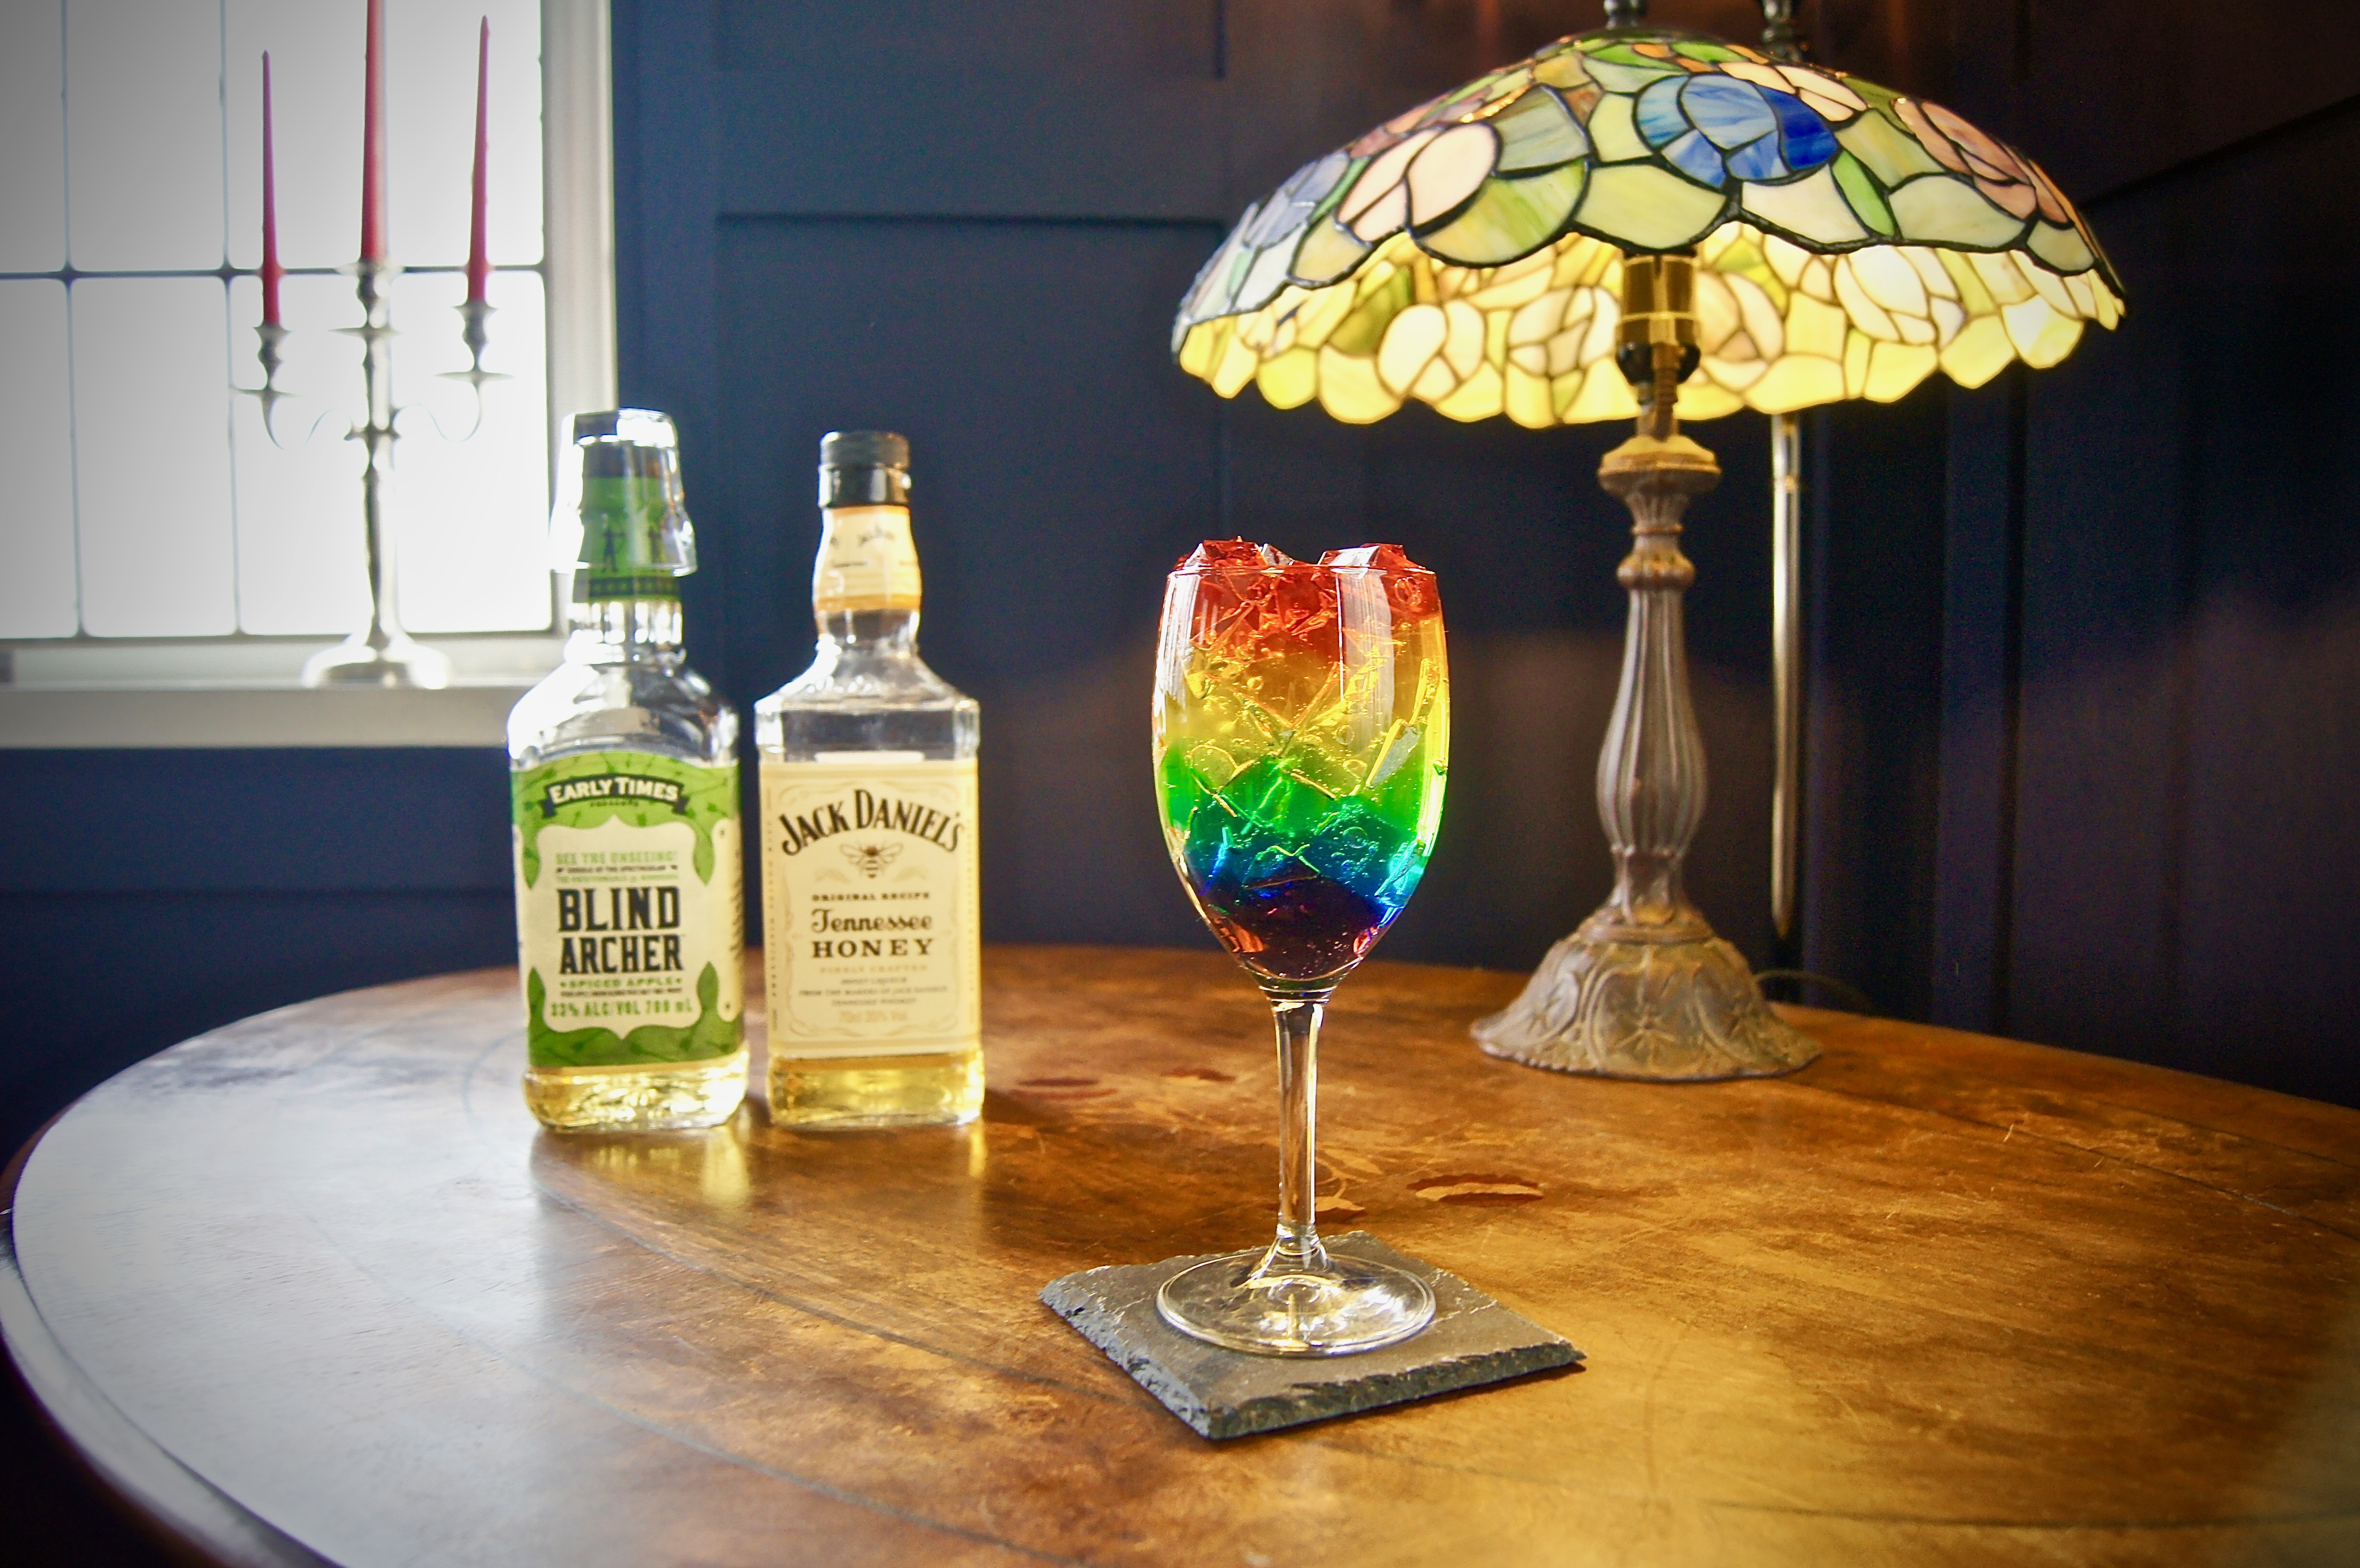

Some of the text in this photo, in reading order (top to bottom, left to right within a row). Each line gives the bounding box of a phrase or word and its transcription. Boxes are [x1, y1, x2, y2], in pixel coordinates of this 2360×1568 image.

[548, 776, 679, 805] EARLY TIMES
[778, 789, 962, 856] JACK DANIEL'S
[557, 885, 681, 932] BLIND
[811, 892, 930, 902] ORIGINAL RECIPE
[811, 908, 933, 934] Tennessee
[560, 934, 683, 975] ARCHER
[811, 938, 933, 958] HONEY
[569, 977, 672, 989] SPICED APPLE
